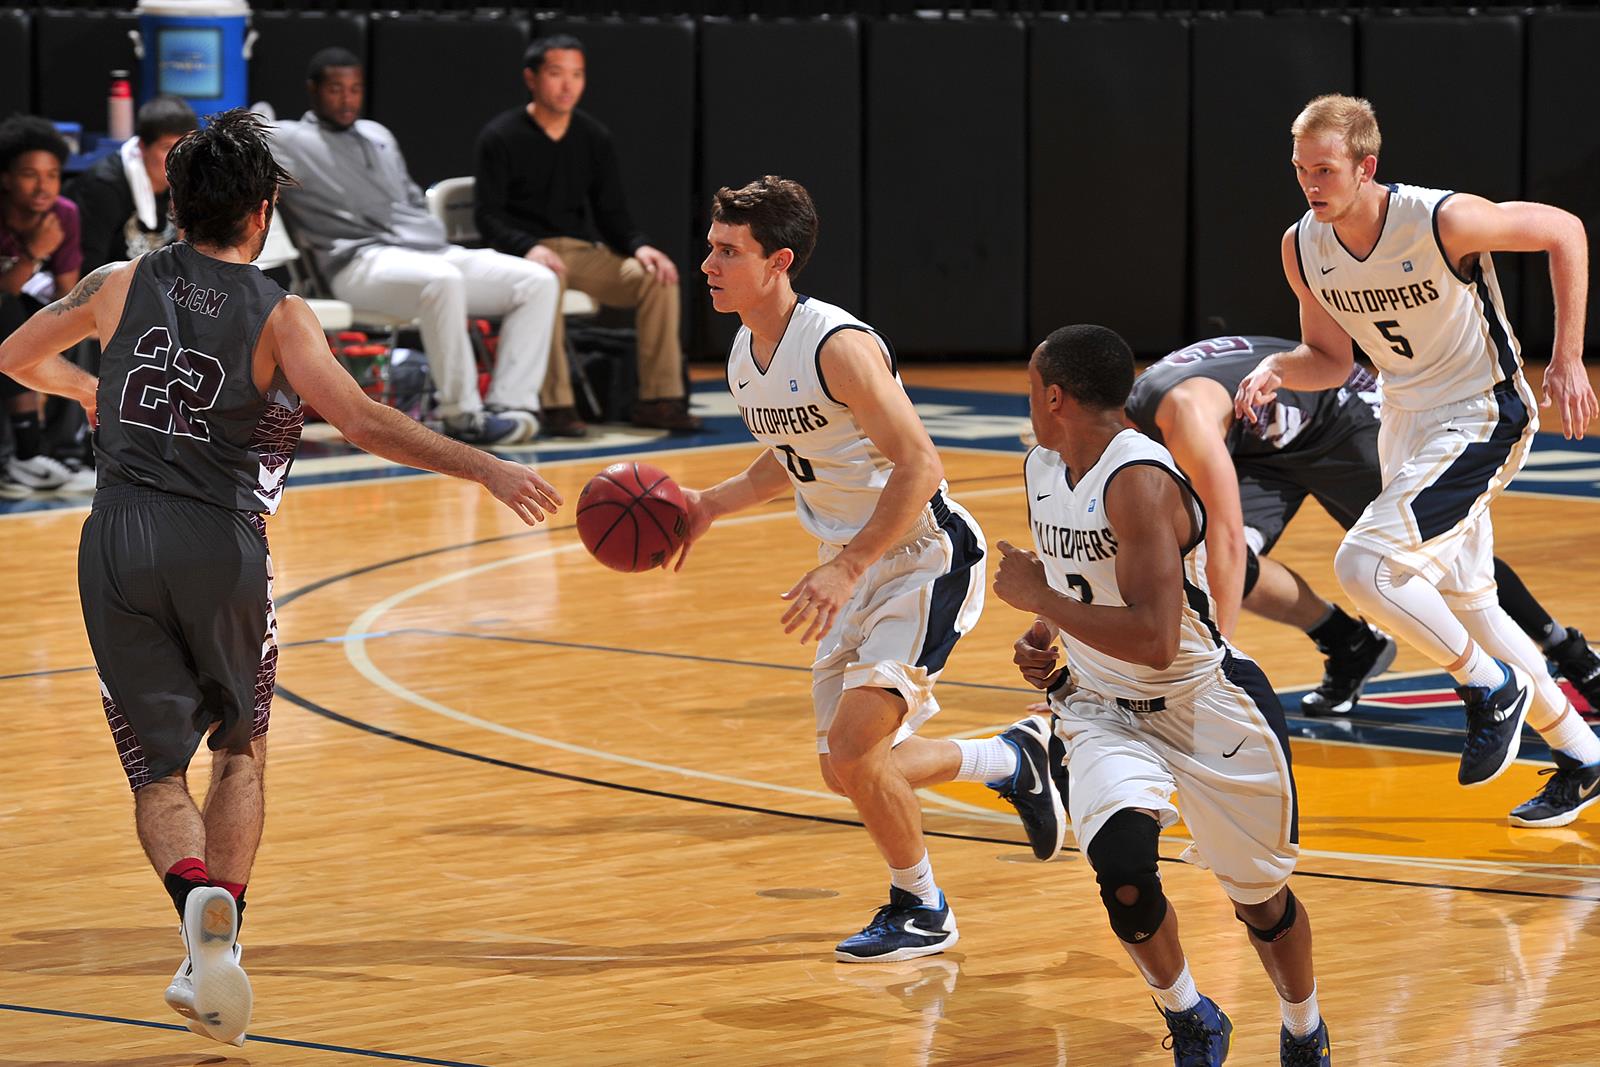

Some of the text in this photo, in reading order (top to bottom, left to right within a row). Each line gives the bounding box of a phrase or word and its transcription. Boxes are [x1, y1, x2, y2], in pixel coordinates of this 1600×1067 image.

[1373, 320, 1414, 360] 5
[119, 326, 226, 442] 22
[775, 444, 817, 483] 0
